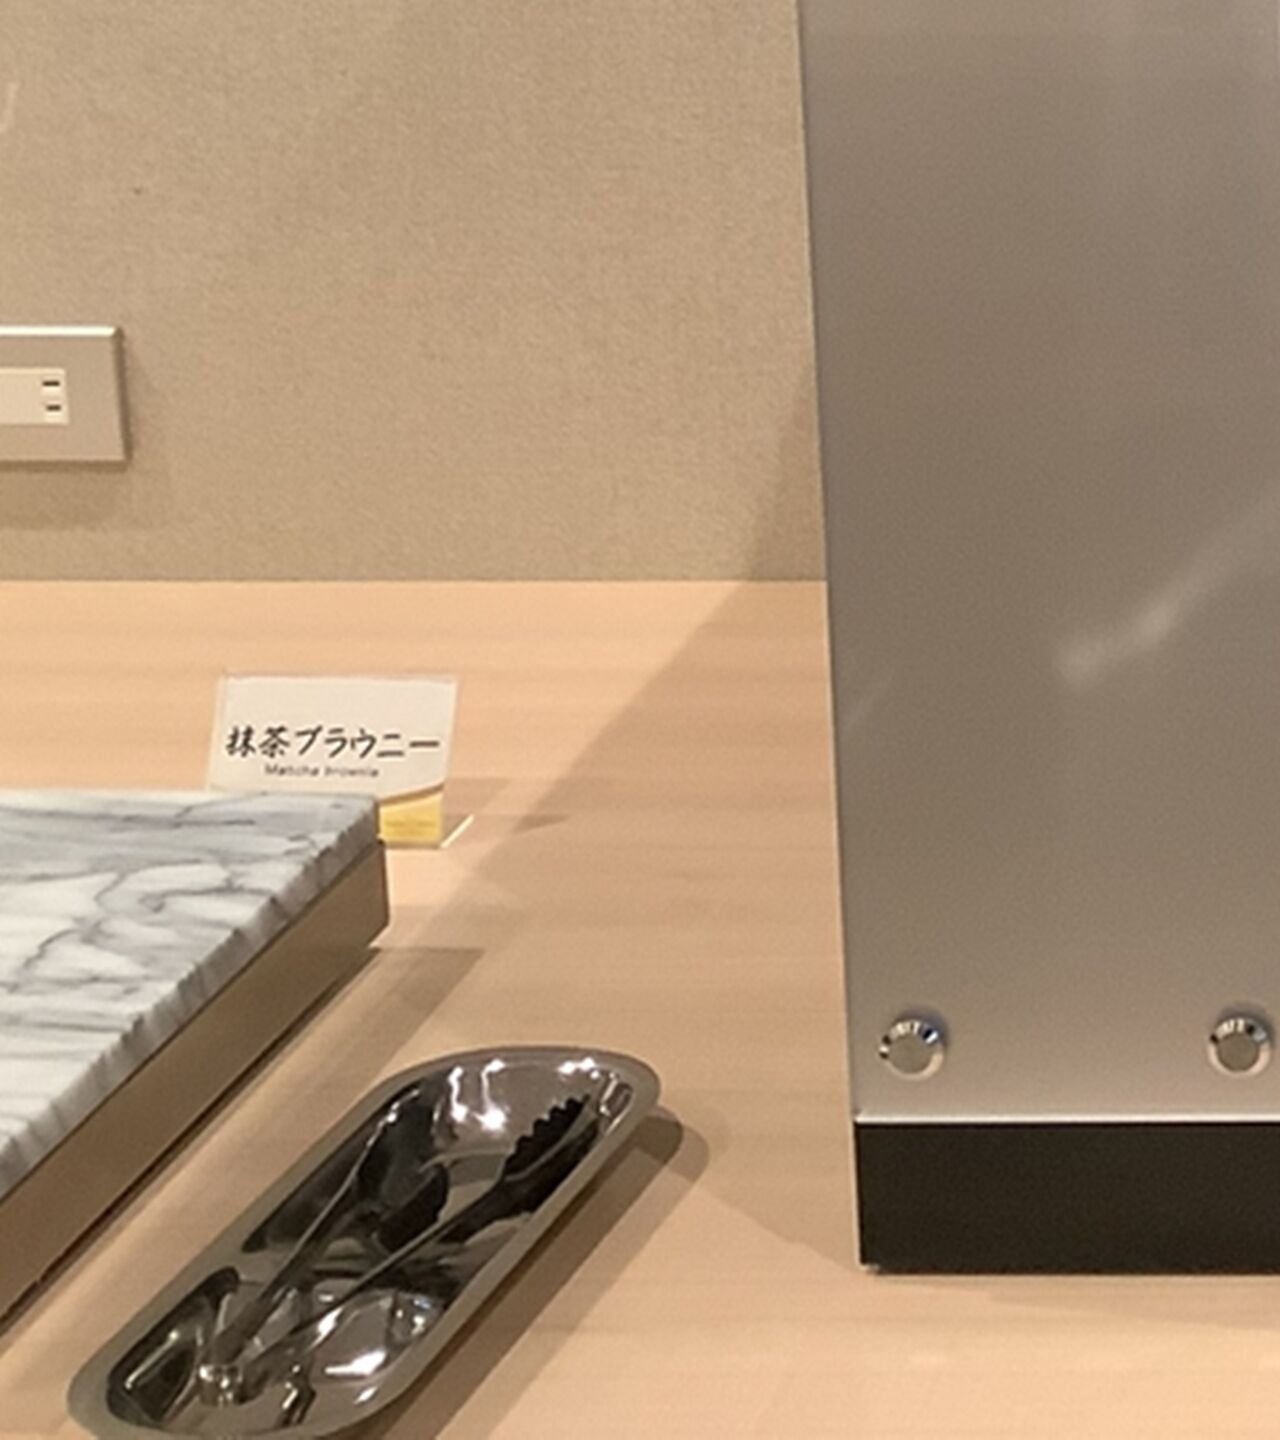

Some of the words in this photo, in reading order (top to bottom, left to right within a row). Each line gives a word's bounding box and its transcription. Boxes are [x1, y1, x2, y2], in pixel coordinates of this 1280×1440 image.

[225, 724, 441, 759] 抹茶ブラウニー
